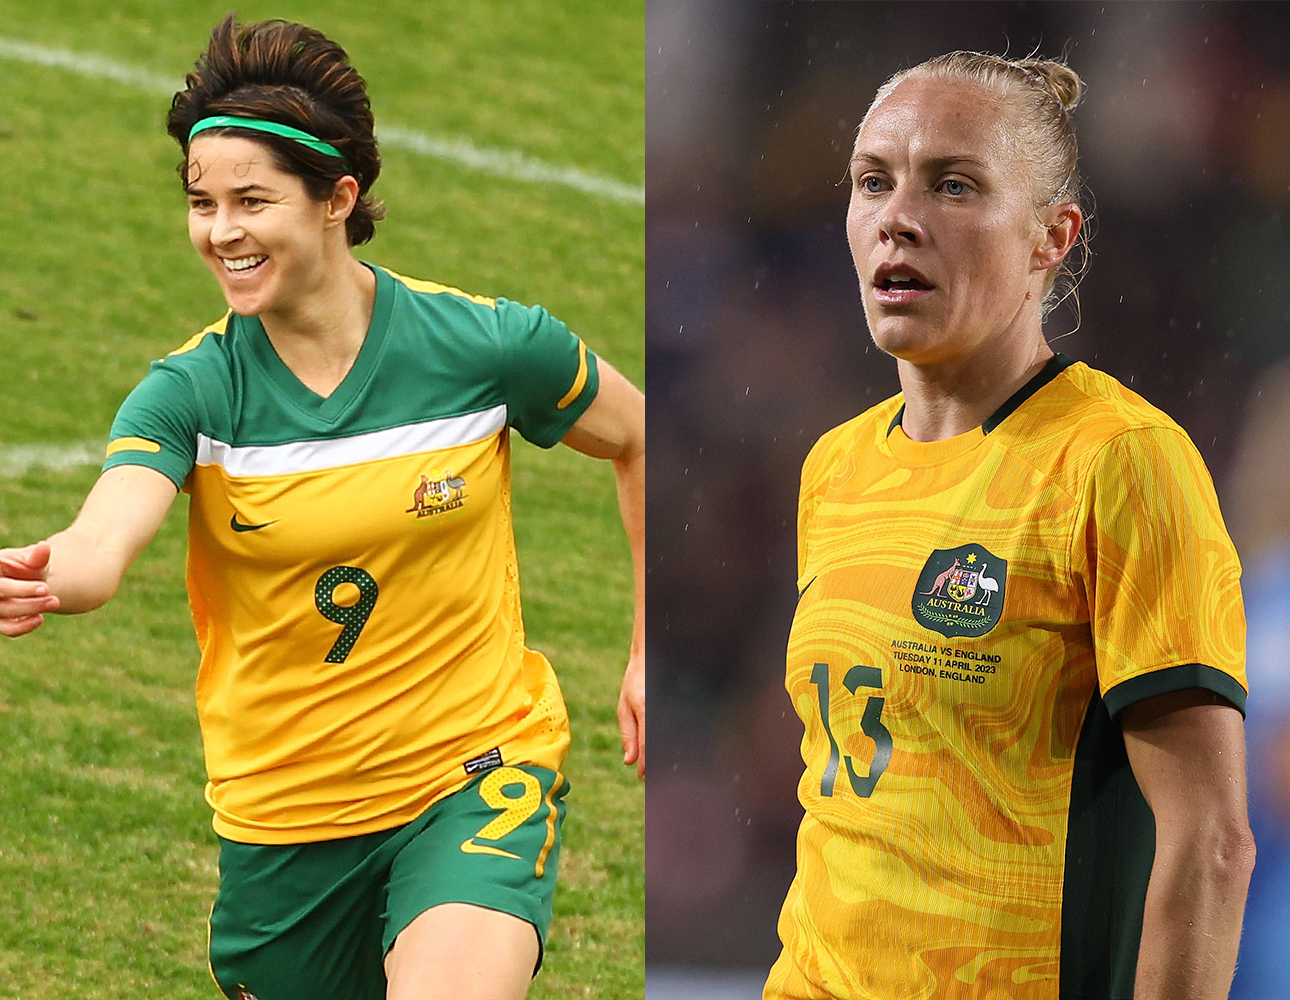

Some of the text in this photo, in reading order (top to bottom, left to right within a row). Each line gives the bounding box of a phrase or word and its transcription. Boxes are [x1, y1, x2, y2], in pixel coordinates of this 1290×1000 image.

[314, 565, 379, 664] 9
[926, 598, 986, 617] AUSTRALIA
[891, 640, 1002, 663] AUSTRALIA VS ENGLAND
[893, 651, 996, 674] TUESDAY 11 APRIL 2023
[899, 663, 986, 684] LONDON, ENGLAND
[810, 663, 893, 798] 13
[475, 766, 543, 841] 9
